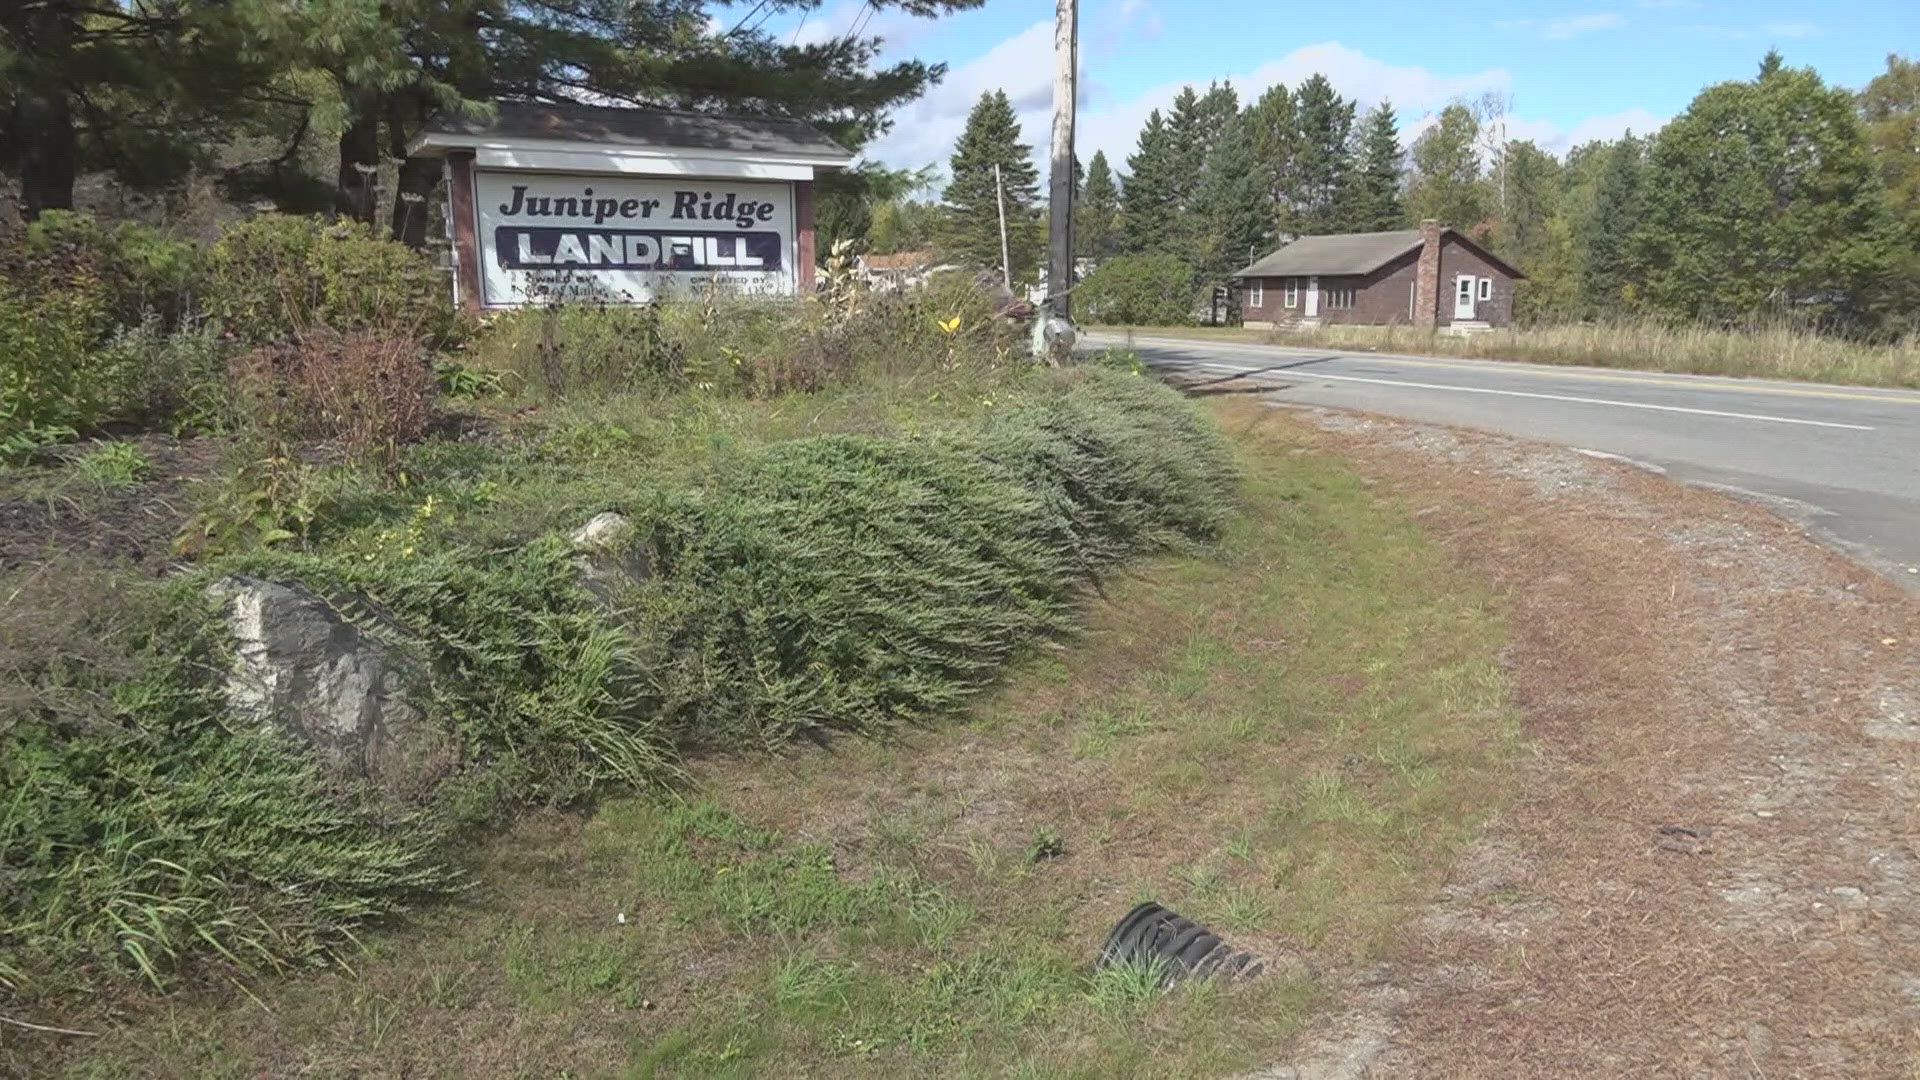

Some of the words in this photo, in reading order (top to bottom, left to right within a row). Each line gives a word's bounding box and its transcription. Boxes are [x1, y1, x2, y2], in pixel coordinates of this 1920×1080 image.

[499, 185, 660, 225] Juniper
[670, 190, 775, 229] Ridge
[517, 232, 764, 266] LANDFILL
